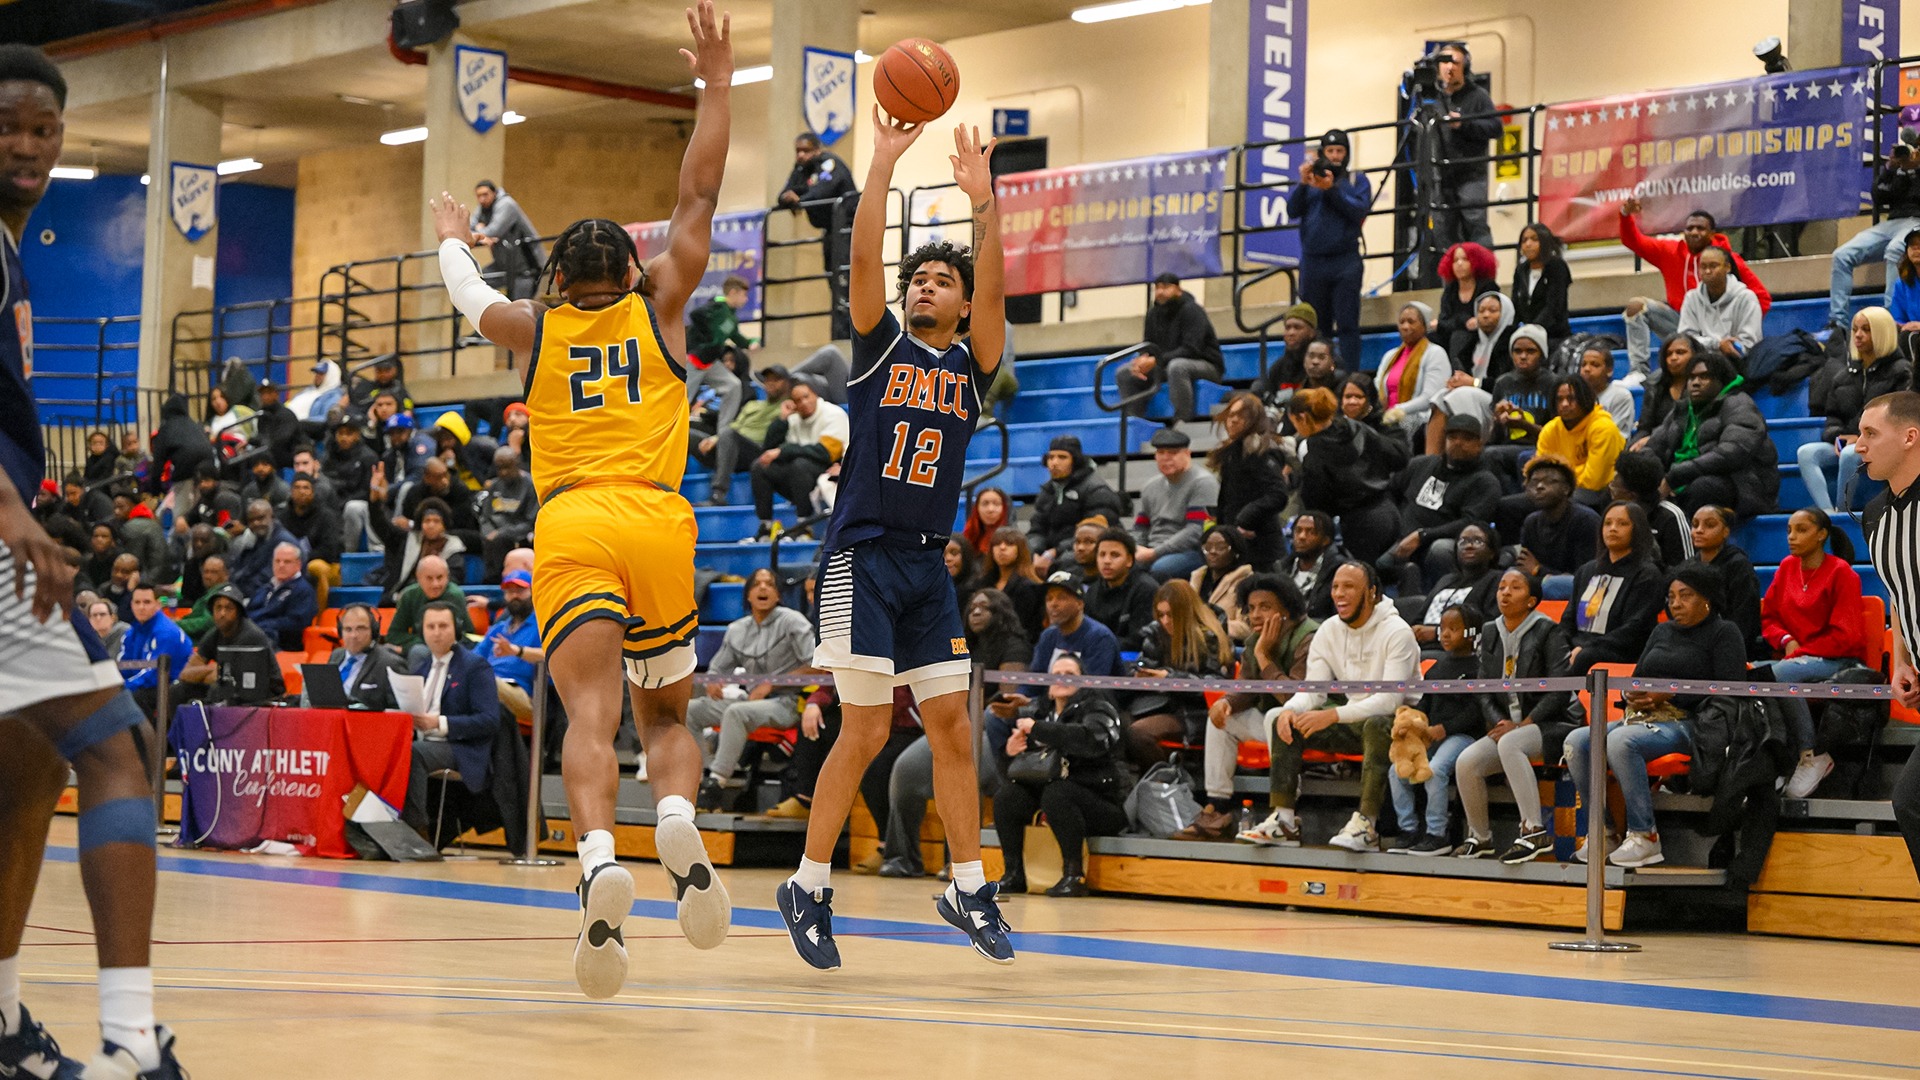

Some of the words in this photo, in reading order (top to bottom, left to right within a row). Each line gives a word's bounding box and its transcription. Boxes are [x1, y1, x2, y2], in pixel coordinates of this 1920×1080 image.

[1260, 0, 1293, 227] TENNIS
[1552, 146, 1613, 177] CUNY
[1622, 121, 1853, 169] CHAMPIONSHIPS
[1050, 191, 1219, 228] CHAMPIONSHIPS
[1594, 170, 1797, 203] www.CUNYAthletics.com
[1190, 224, 1219, 245] Appl
[568, 337, 642, 413] 24
[880, 363, 969, 421] BMCC
[881, 420, 943, 488] 12
[193, 747, 246, 774] CUNY
[251, 748, 330, 776] ATHLETI
[232, 768, 323, 808] Conferenc
